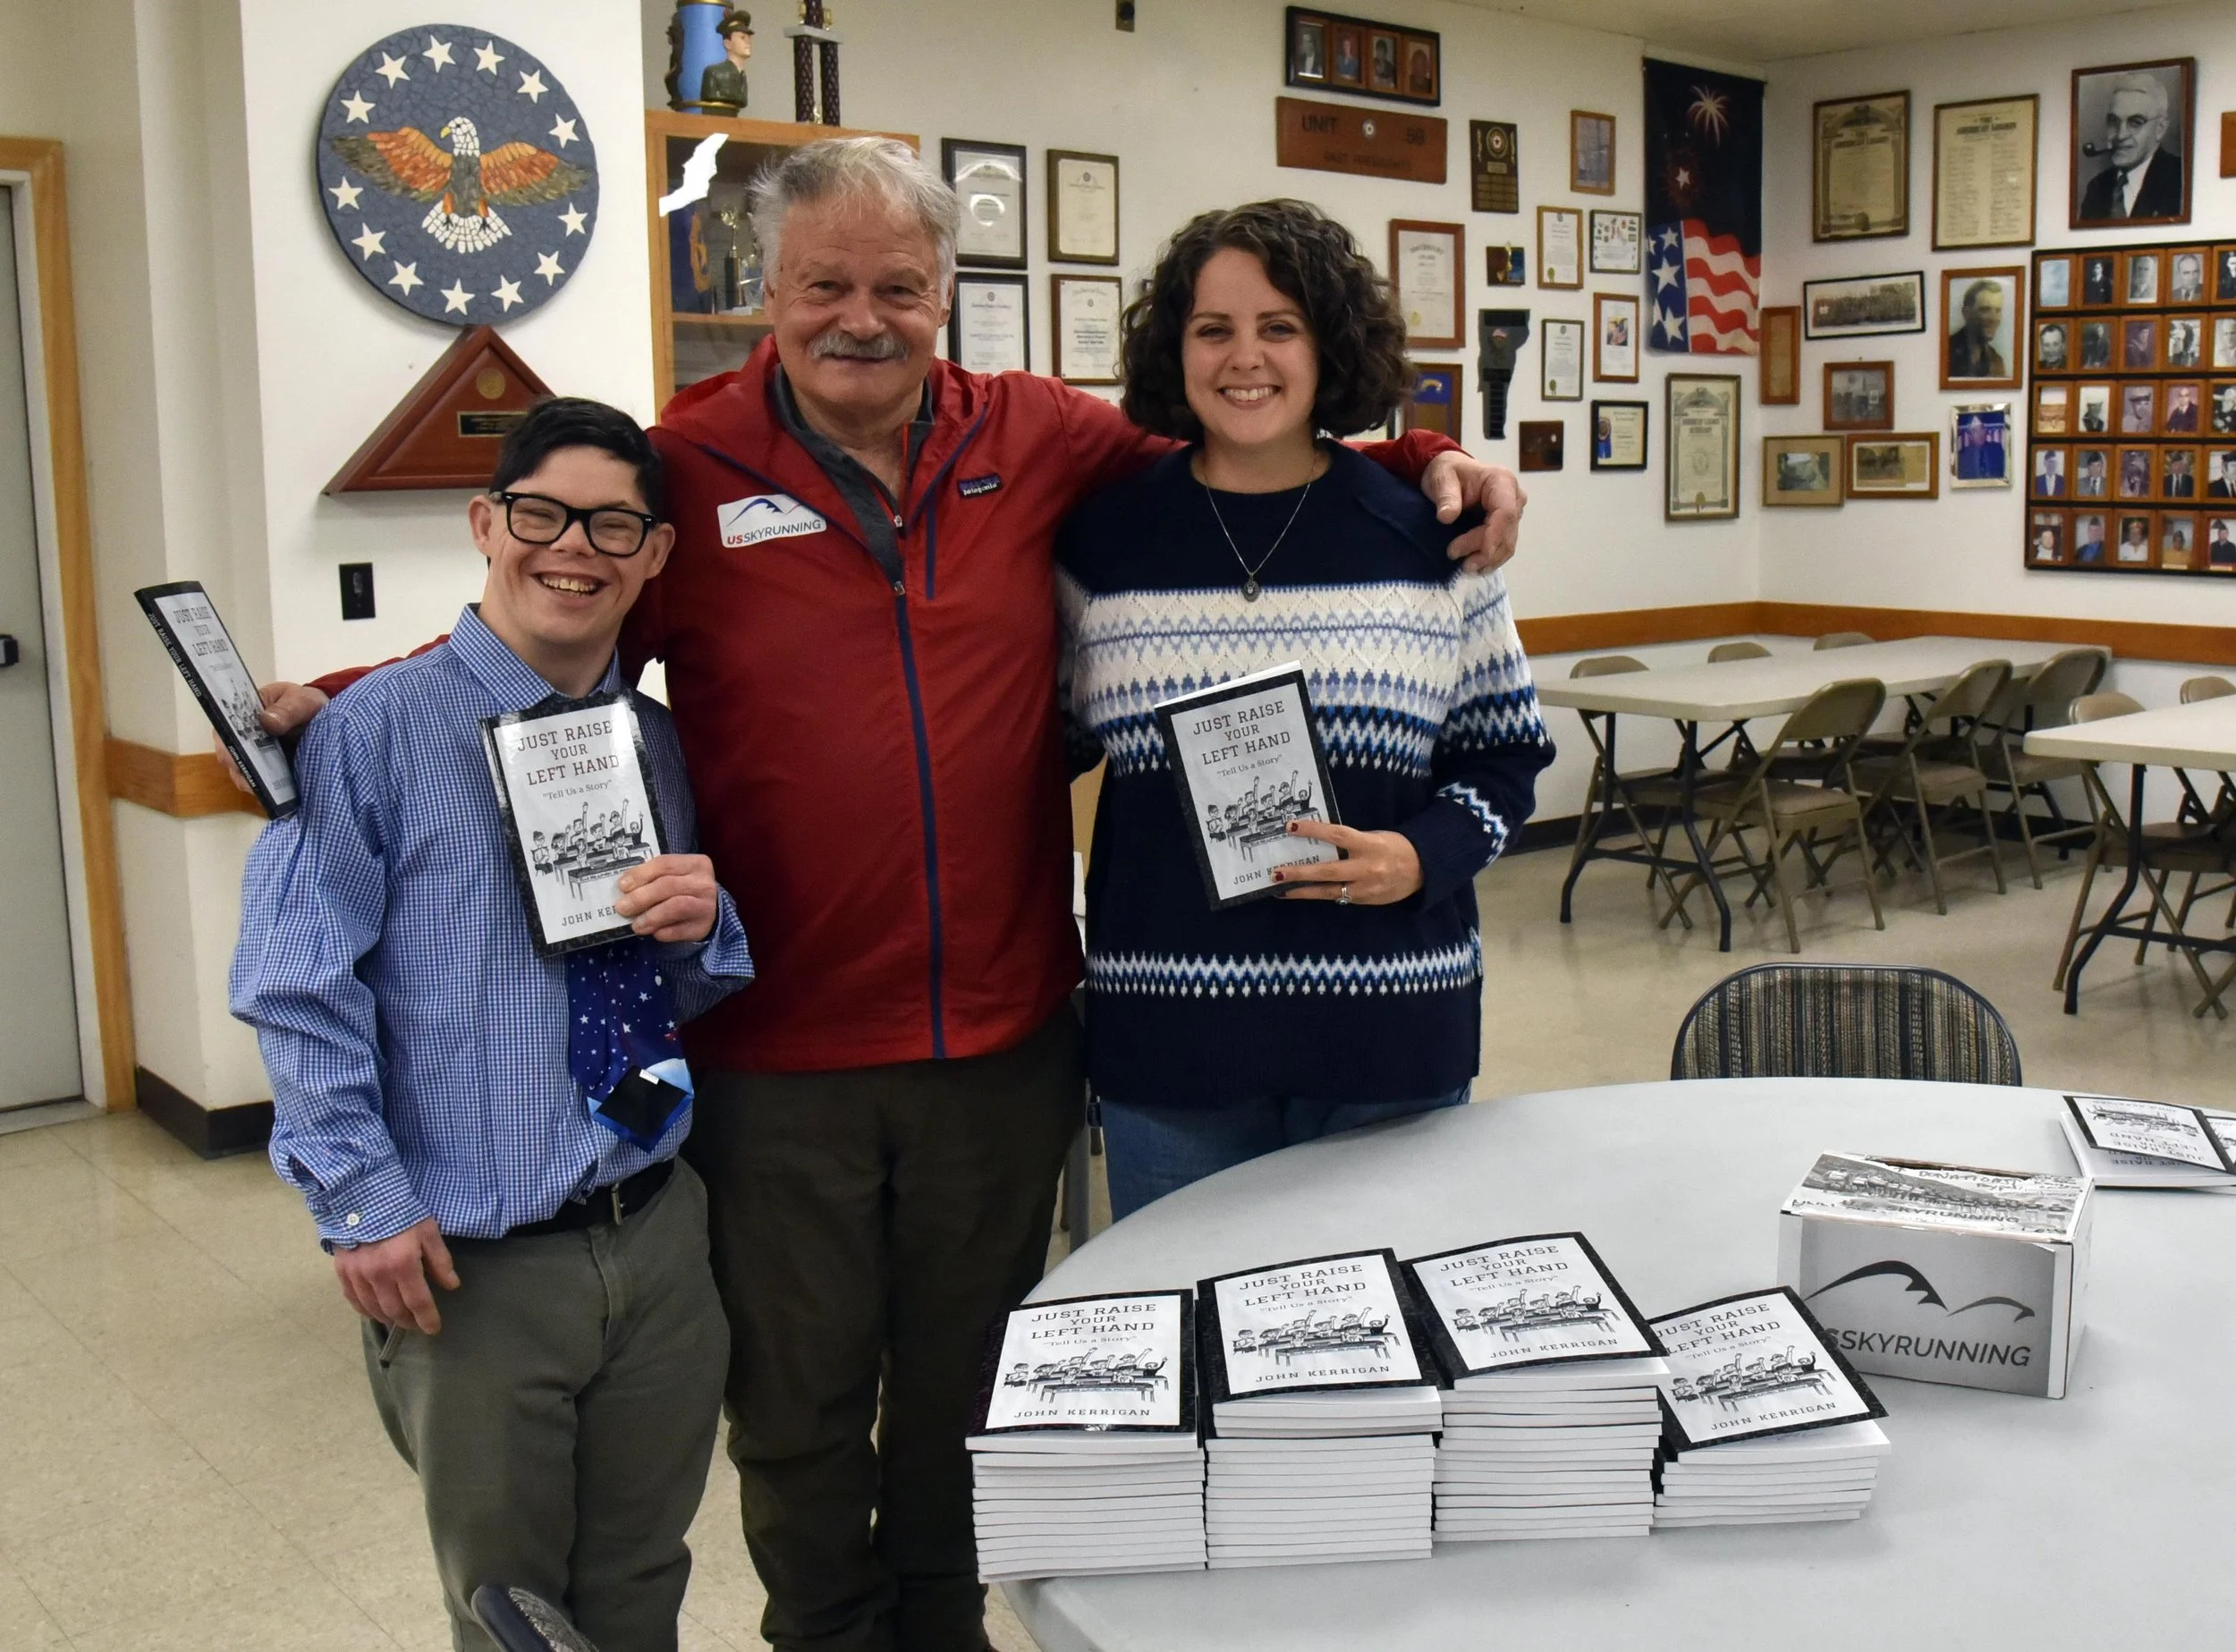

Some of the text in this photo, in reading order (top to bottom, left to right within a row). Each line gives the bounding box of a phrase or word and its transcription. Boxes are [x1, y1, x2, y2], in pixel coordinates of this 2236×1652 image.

[1300, 114, 1338, 134] UNIT
[726, 519, 821, 546] USSKYRUNNING
[148, 612, 161, 627] JUST
[169, 646, 182, 664] YOUR
[179, 662, 191, 681] LEFT
[189, 678, 202, 698] HAND
[1193, 700, 1285, 735] JUST RAISE
[518, 720, 613, 751] JUST RAISE
[1224, 724, 1260, 741] YOUR
[551, 744, 589, 760] YOUR
[1202, 732, 1292, 766] LEFT HAND
[527, 754, 620, 786] LEFT HAND
[1239, 764, 1249, 773] Us
[566, 787, 577, 796] Us
[1233, 869, 1262, 885] JOHN
[562, 911, 592, 927] JOHN
[1440, 1245, 1559, 1272] JUST RAISE
[1481, 1258, 1527, 1271] YOUR
[1239, 1264, 1363, 1290] JUST RAISE
[1280, 1278, 1326, 1290] YOUR
[1451, 1262, 1569, 1287] LEFT HAND
[1245, 1282, 1367, 1307] LEFT HAND
[1031, 1303, 1156, 1322] JUST RAISE
[1071, 1316, 1116, 1325] YOUR
[1656, 1303, 1770, 1338] JUST RAISE
[1031, 1322, 1155, 1339] LEFT HAND
[1667, 1321, 1782, 1354] LEFT HAND
[1694, 1320, 1740, 1336] YOUR
[1490, 1339, 1618, 1359] JOHN KERRIGAN
[1256, 1366, 1390, 1383] JOHN KERRIGAN
[1014, 1409, 1059, 1418] JOHN
[1710, 1402, 1837, 1430] JOHN KERRIGAN
